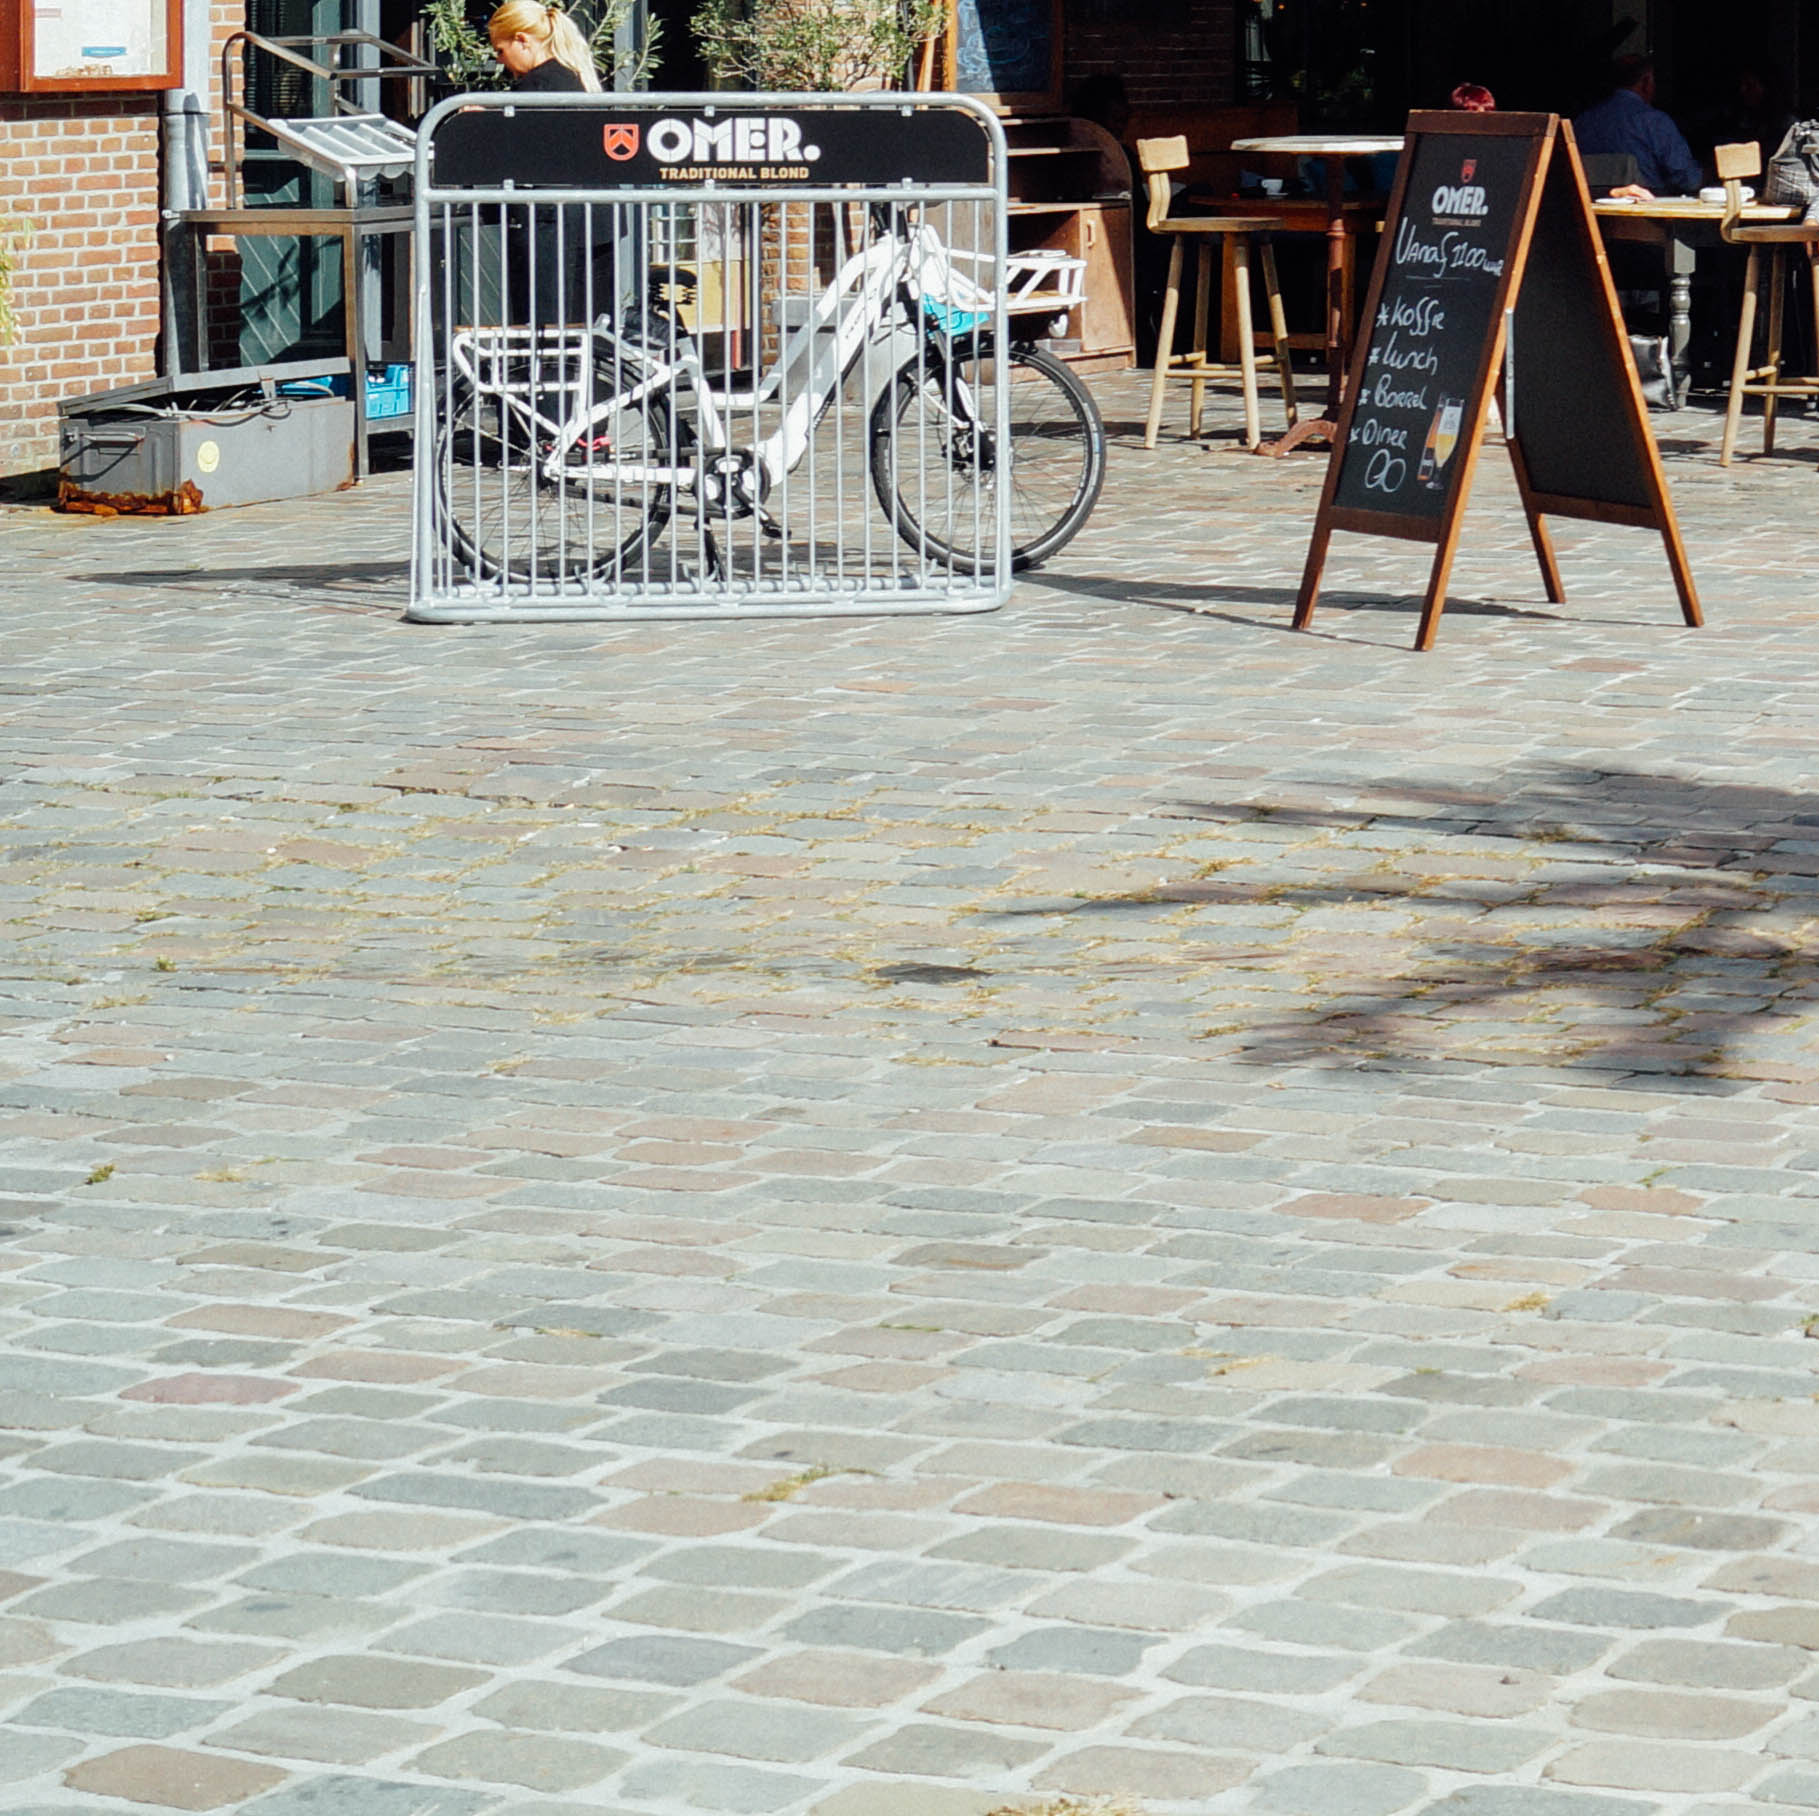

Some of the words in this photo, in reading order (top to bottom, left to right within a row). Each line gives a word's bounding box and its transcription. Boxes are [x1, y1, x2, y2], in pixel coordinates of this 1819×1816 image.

[646, 117, 821, 163] OMER.
[659, 167, 757, 180] TRADITIONAL
[760, 167, 809, 179] BLOND
